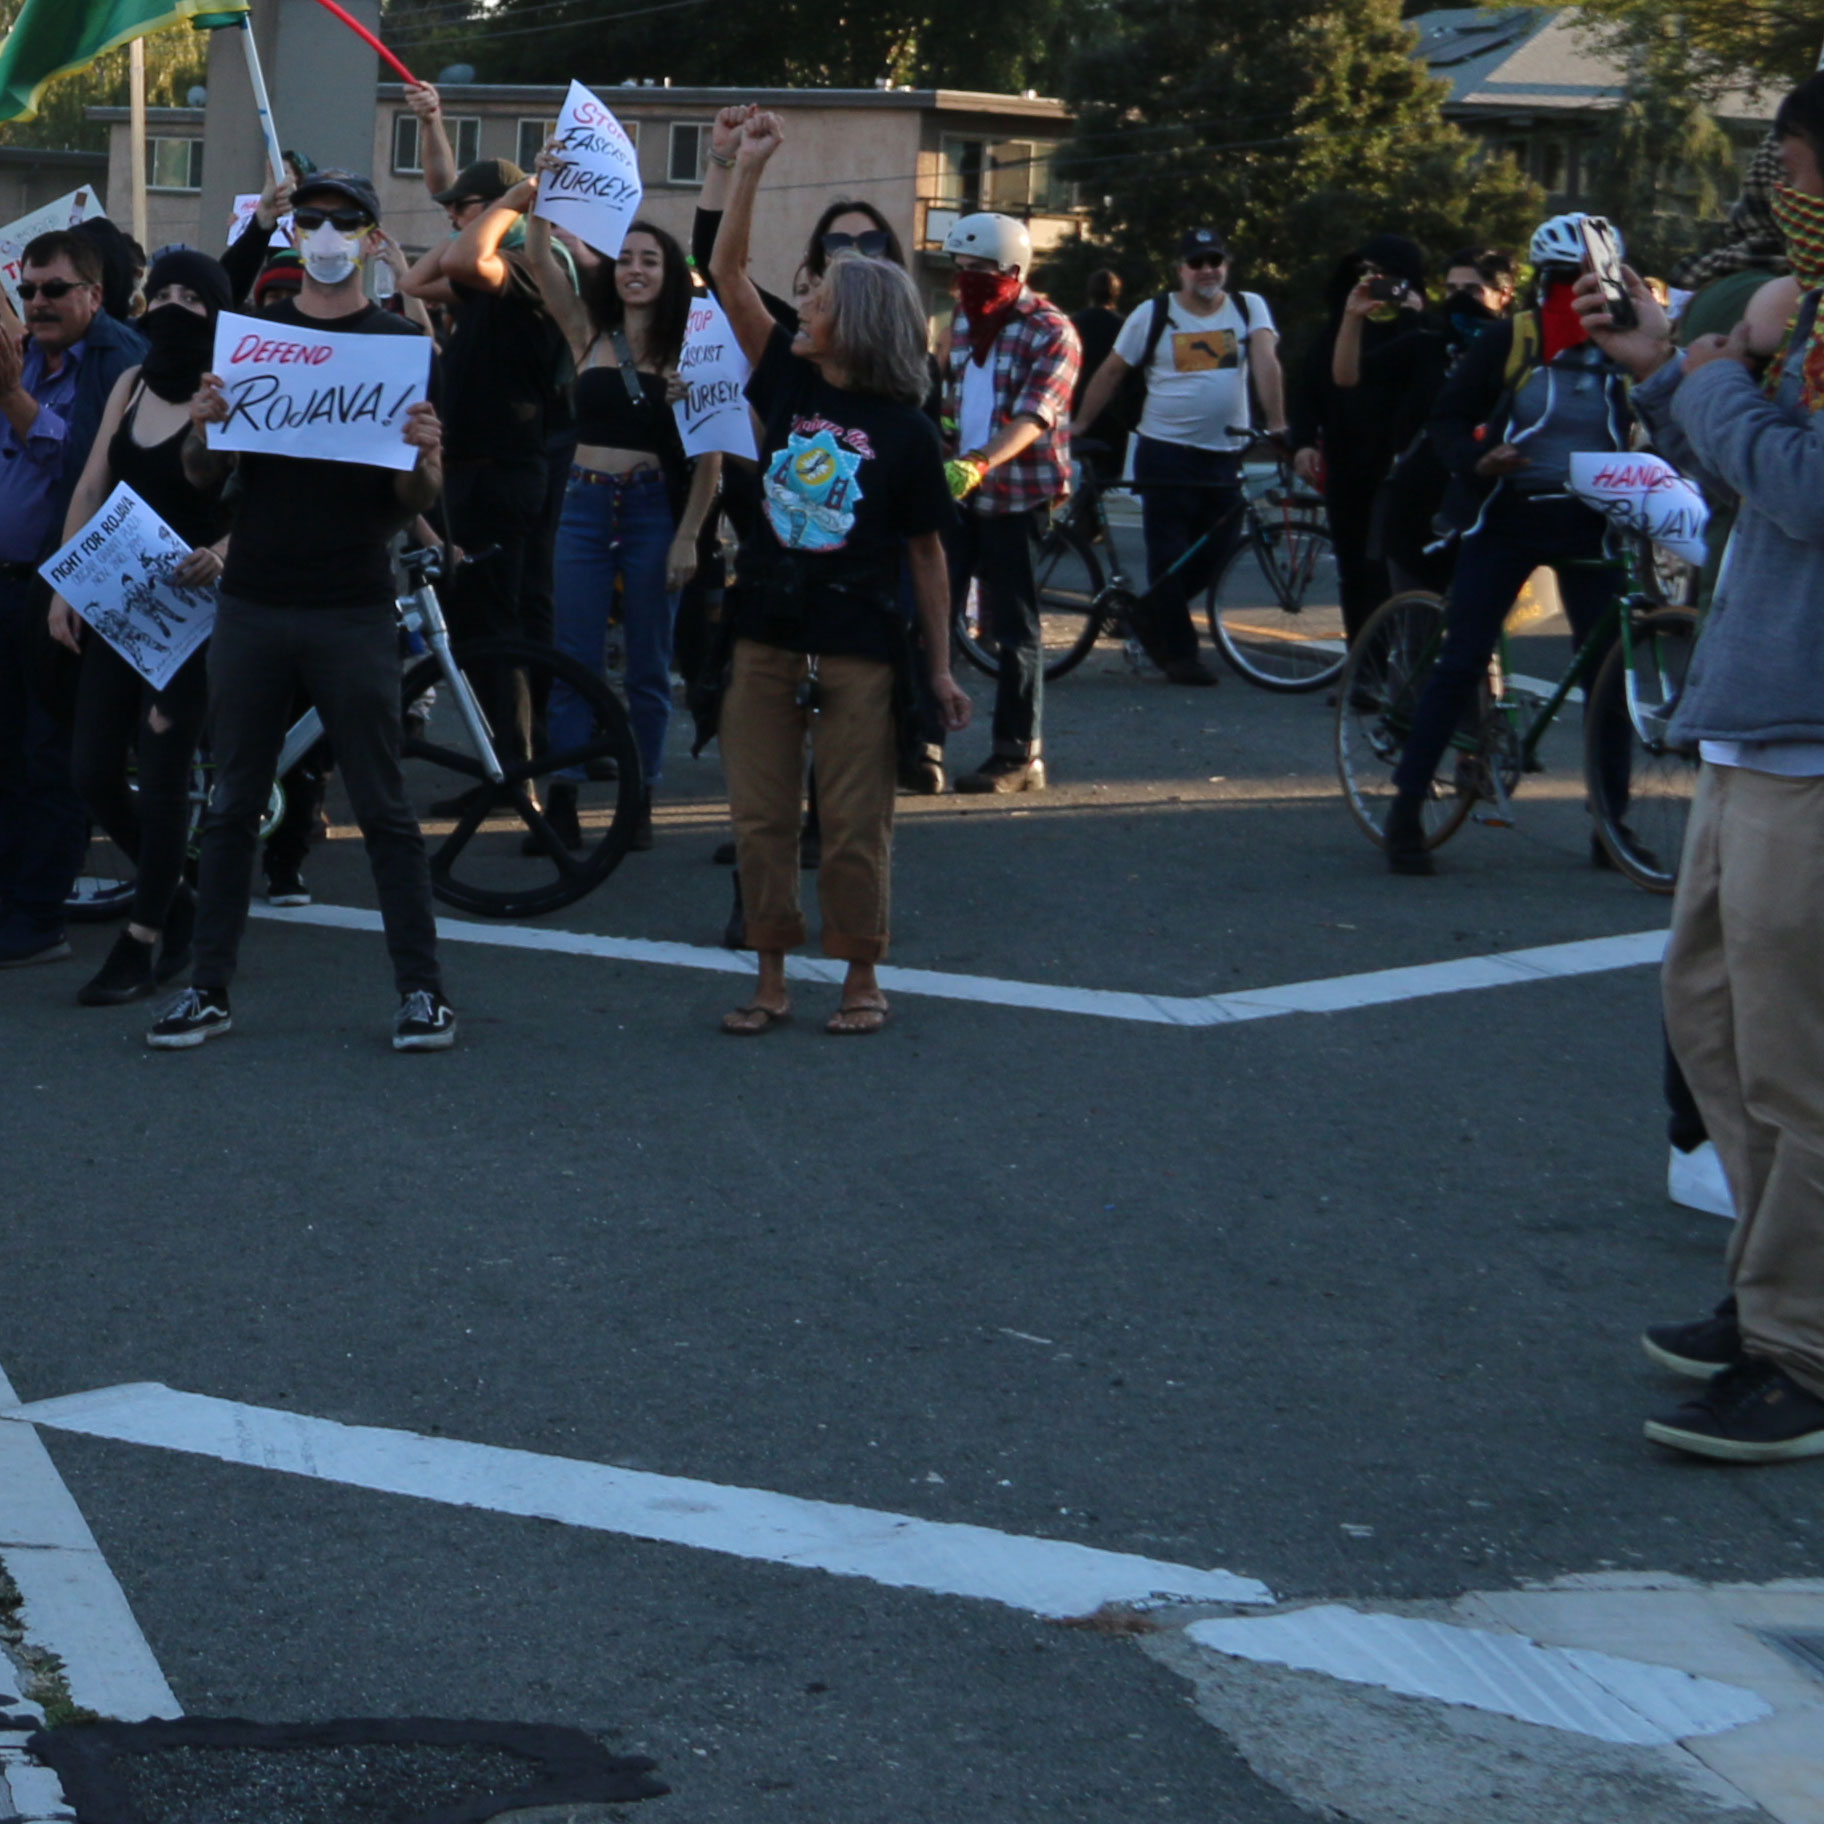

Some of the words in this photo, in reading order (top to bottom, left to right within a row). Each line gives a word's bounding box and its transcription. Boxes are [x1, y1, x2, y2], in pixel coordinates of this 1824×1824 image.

[548, 161, 639, 204] TURKEY!
[685, 309, 714, 337] TOP
[230, 334, 335, 367] DEFEND
[680, 342, 725, 372] ASCIST
[220, 374, 417, 435] ROJAVA!
[683, 380, 740, 422] TURKEY!
[1592, 463, 1675, 490] HANDS
[50, 549, 84, 584] FIGHT
[81, 529, 106, 557] FOR
[100, 494, 137, 536] ROJAVA
